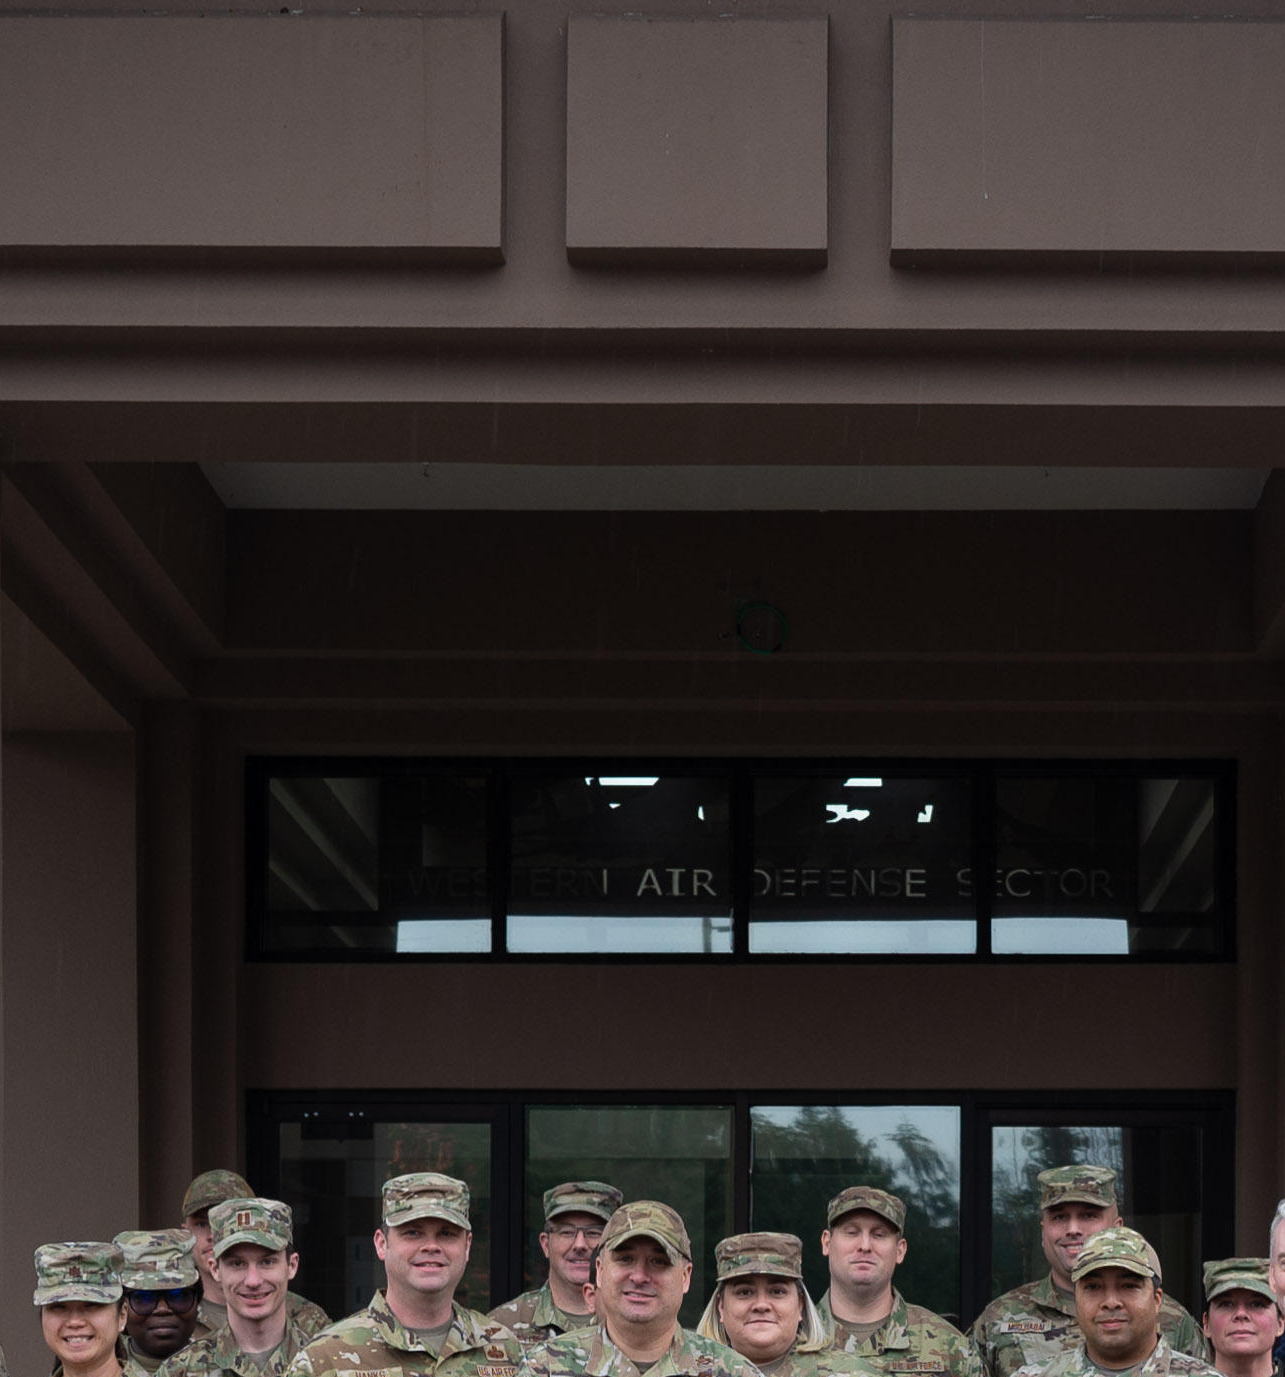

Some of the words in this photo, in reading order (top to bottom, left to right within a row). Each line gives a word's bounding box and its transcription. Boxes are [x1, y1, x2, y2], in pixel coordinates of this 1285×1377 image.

[407, 867, 608, 897] WESERN
[636, 867, 718, 897] AIR
[752, 867, 927, 898] DEFENSE
